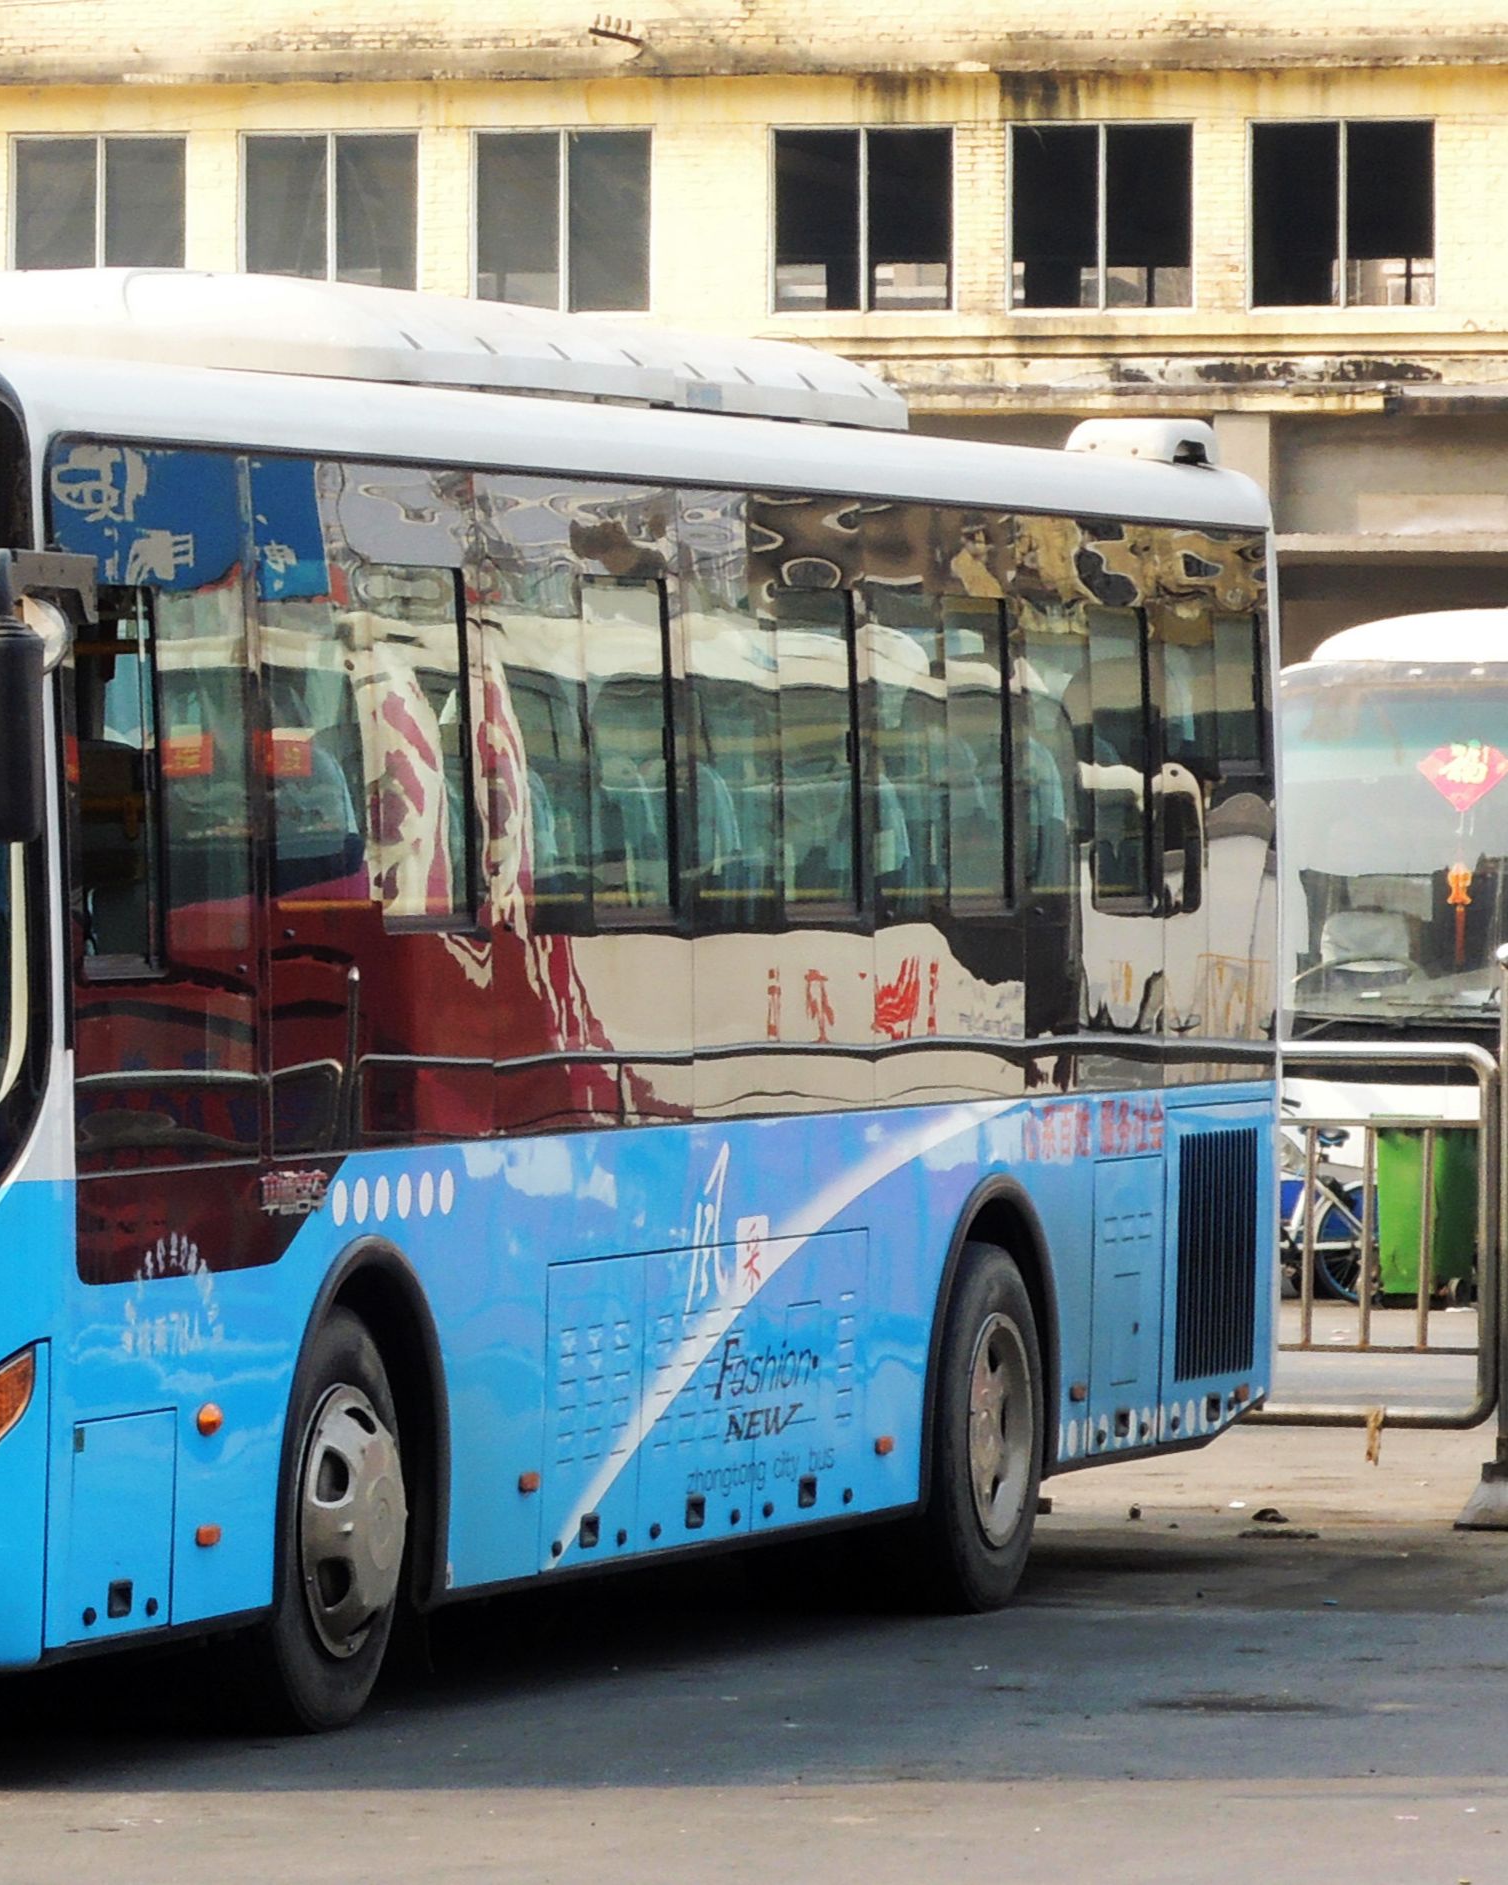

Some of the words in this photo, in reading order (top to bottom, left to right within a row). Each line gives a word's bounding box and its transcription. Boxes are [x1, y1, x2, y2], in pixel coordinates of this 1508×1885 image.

[723, 1402, 803, 1444] NEW
[773, 1450, 799, 1482] city
[808, 1446, 836, 1473] bus
